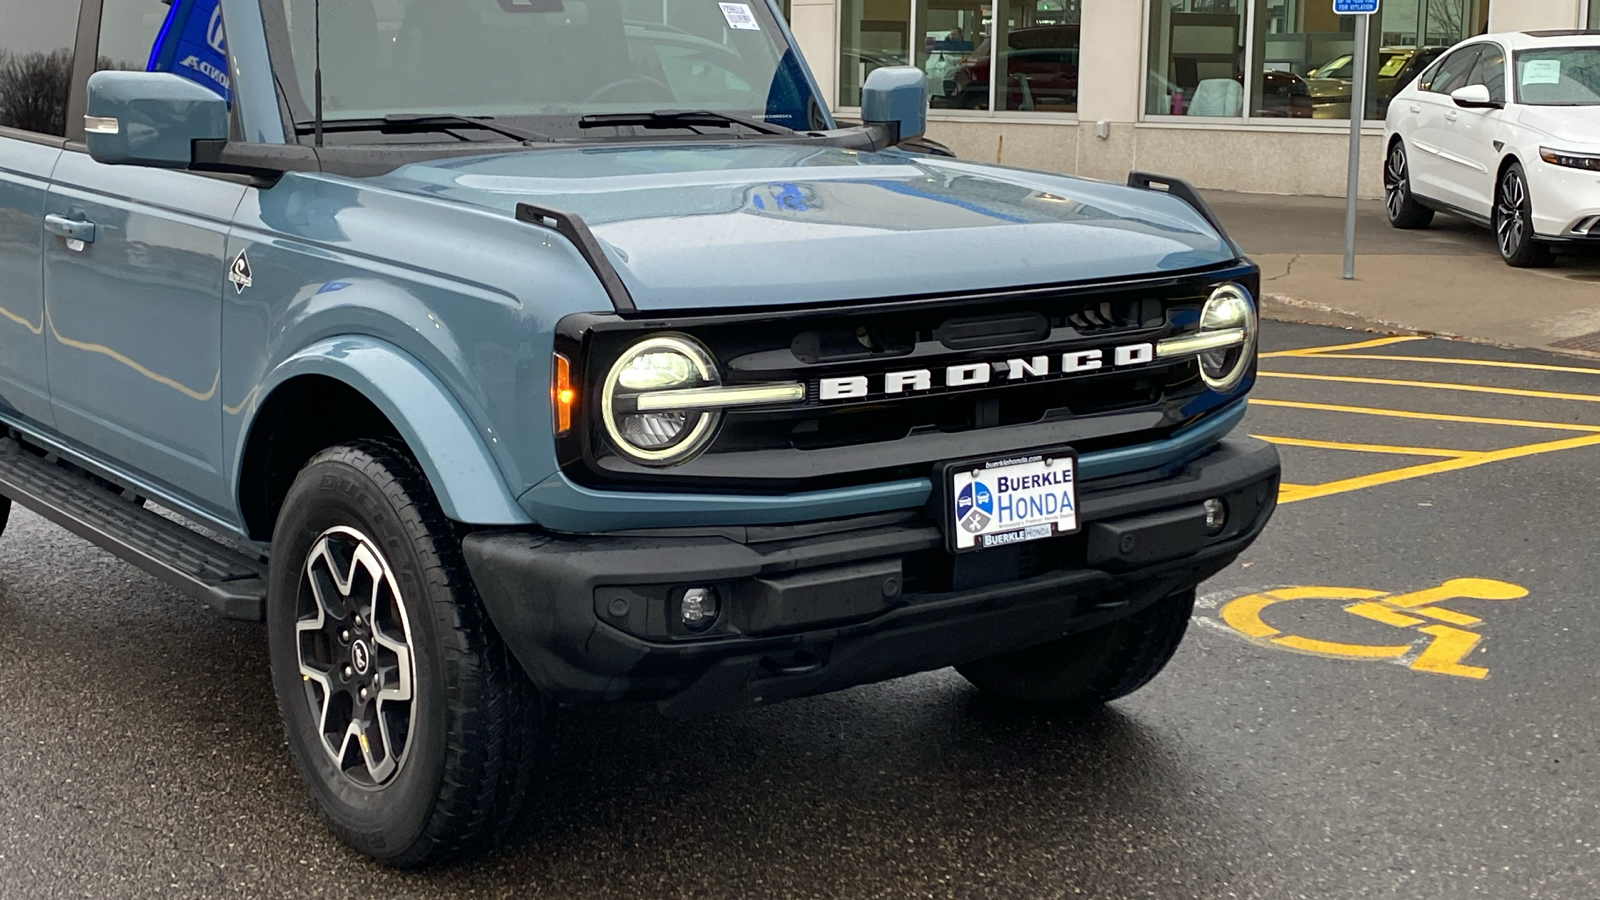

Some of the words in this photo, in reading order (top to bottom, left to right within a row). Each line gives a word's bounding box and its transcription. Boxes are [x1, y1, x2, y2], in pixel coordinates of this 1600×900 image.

[819, 342, 1153, 400] BRONCO
[985, 455, 1043, 469] buerklehonda.com
[997, 469, 1073, 494] BUERKLE
[998, 490, 1074, 523] HONDA
[984, 529, 1025, 546] BUERKLE
[1026, 525, 1050, 539] HONDA
